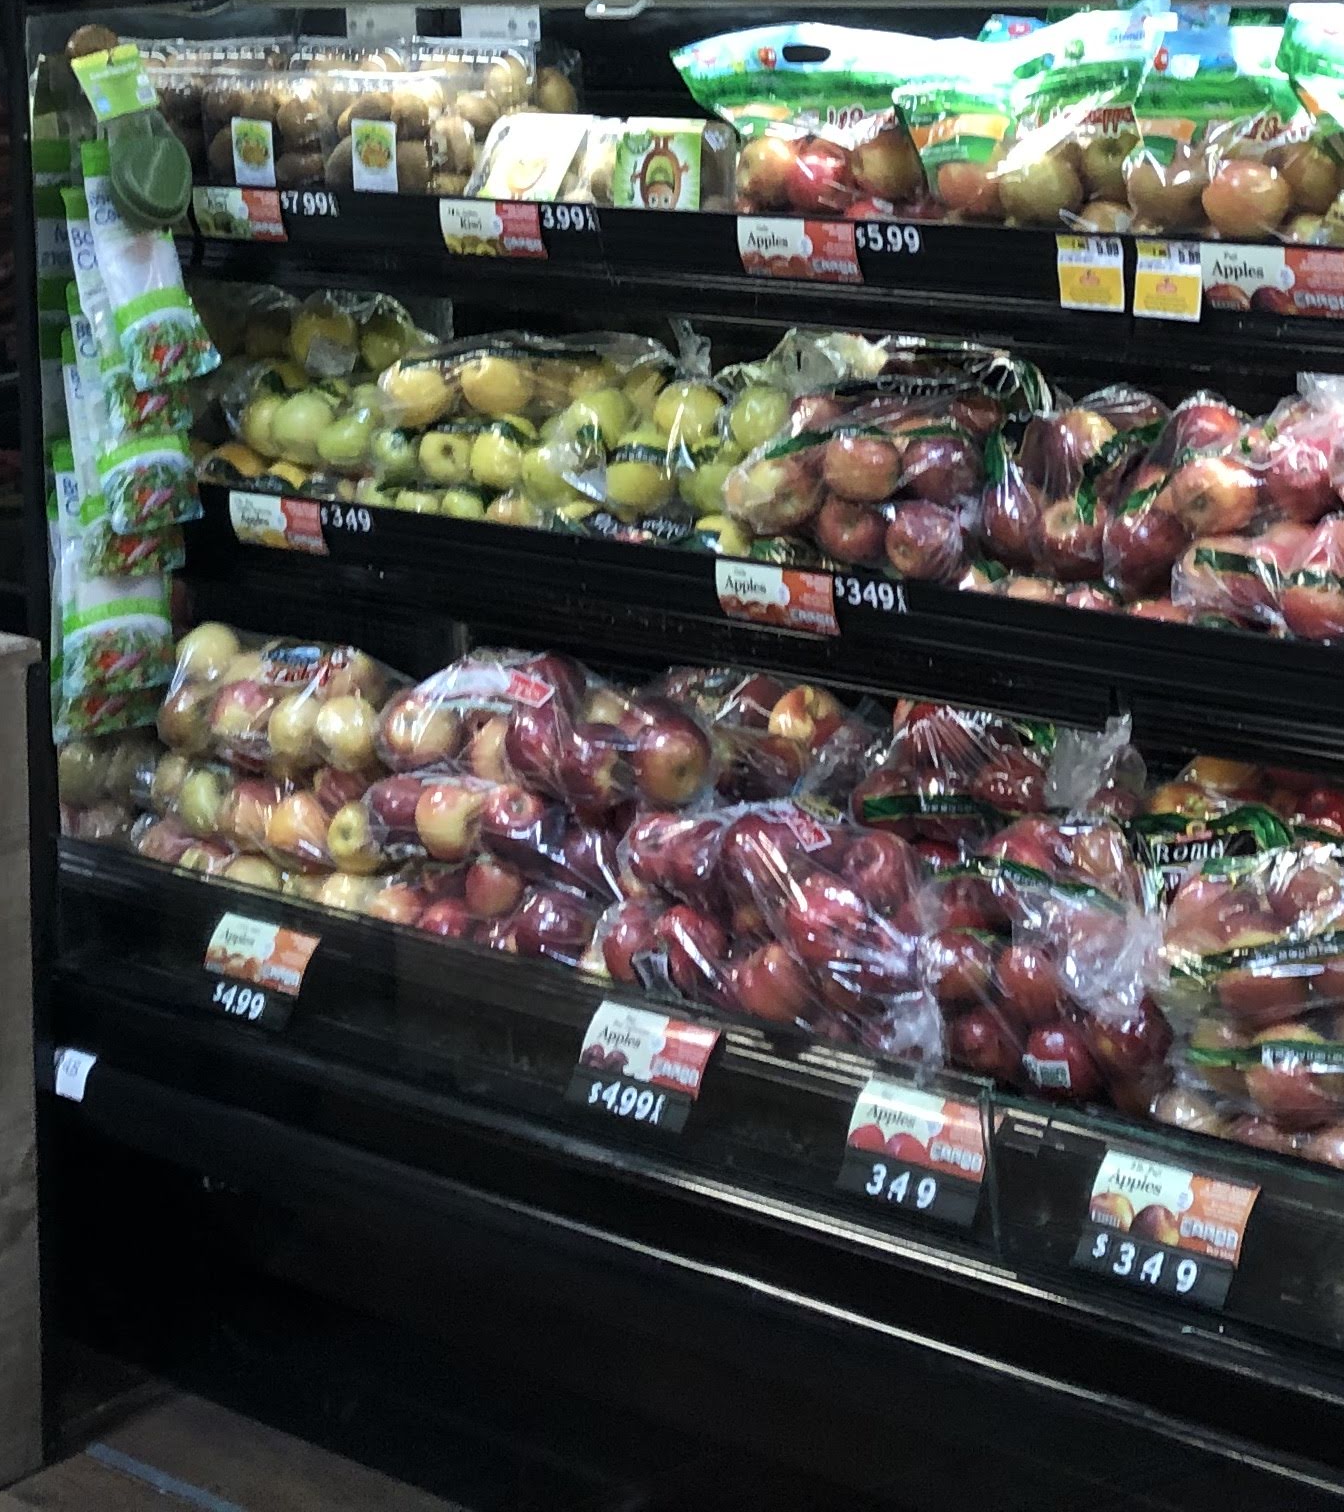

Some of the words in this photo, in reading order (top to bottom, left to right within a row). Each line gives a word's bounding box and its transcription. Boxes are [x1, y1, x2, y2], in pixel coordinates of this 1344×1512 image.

[747, 231, 789, 250] Apples
[856, 222, 921, 254] $5.99
[1212, 259, 1265, 280] Apples
[724, 575, 767, 595] Apples
[212, 981, 266, 1021] $4.99
[597, 1025, 642, 1050] Apples
[867, 1104, 918, 1129] Apples
[1108, 1166, 1163, 1196] Apples
